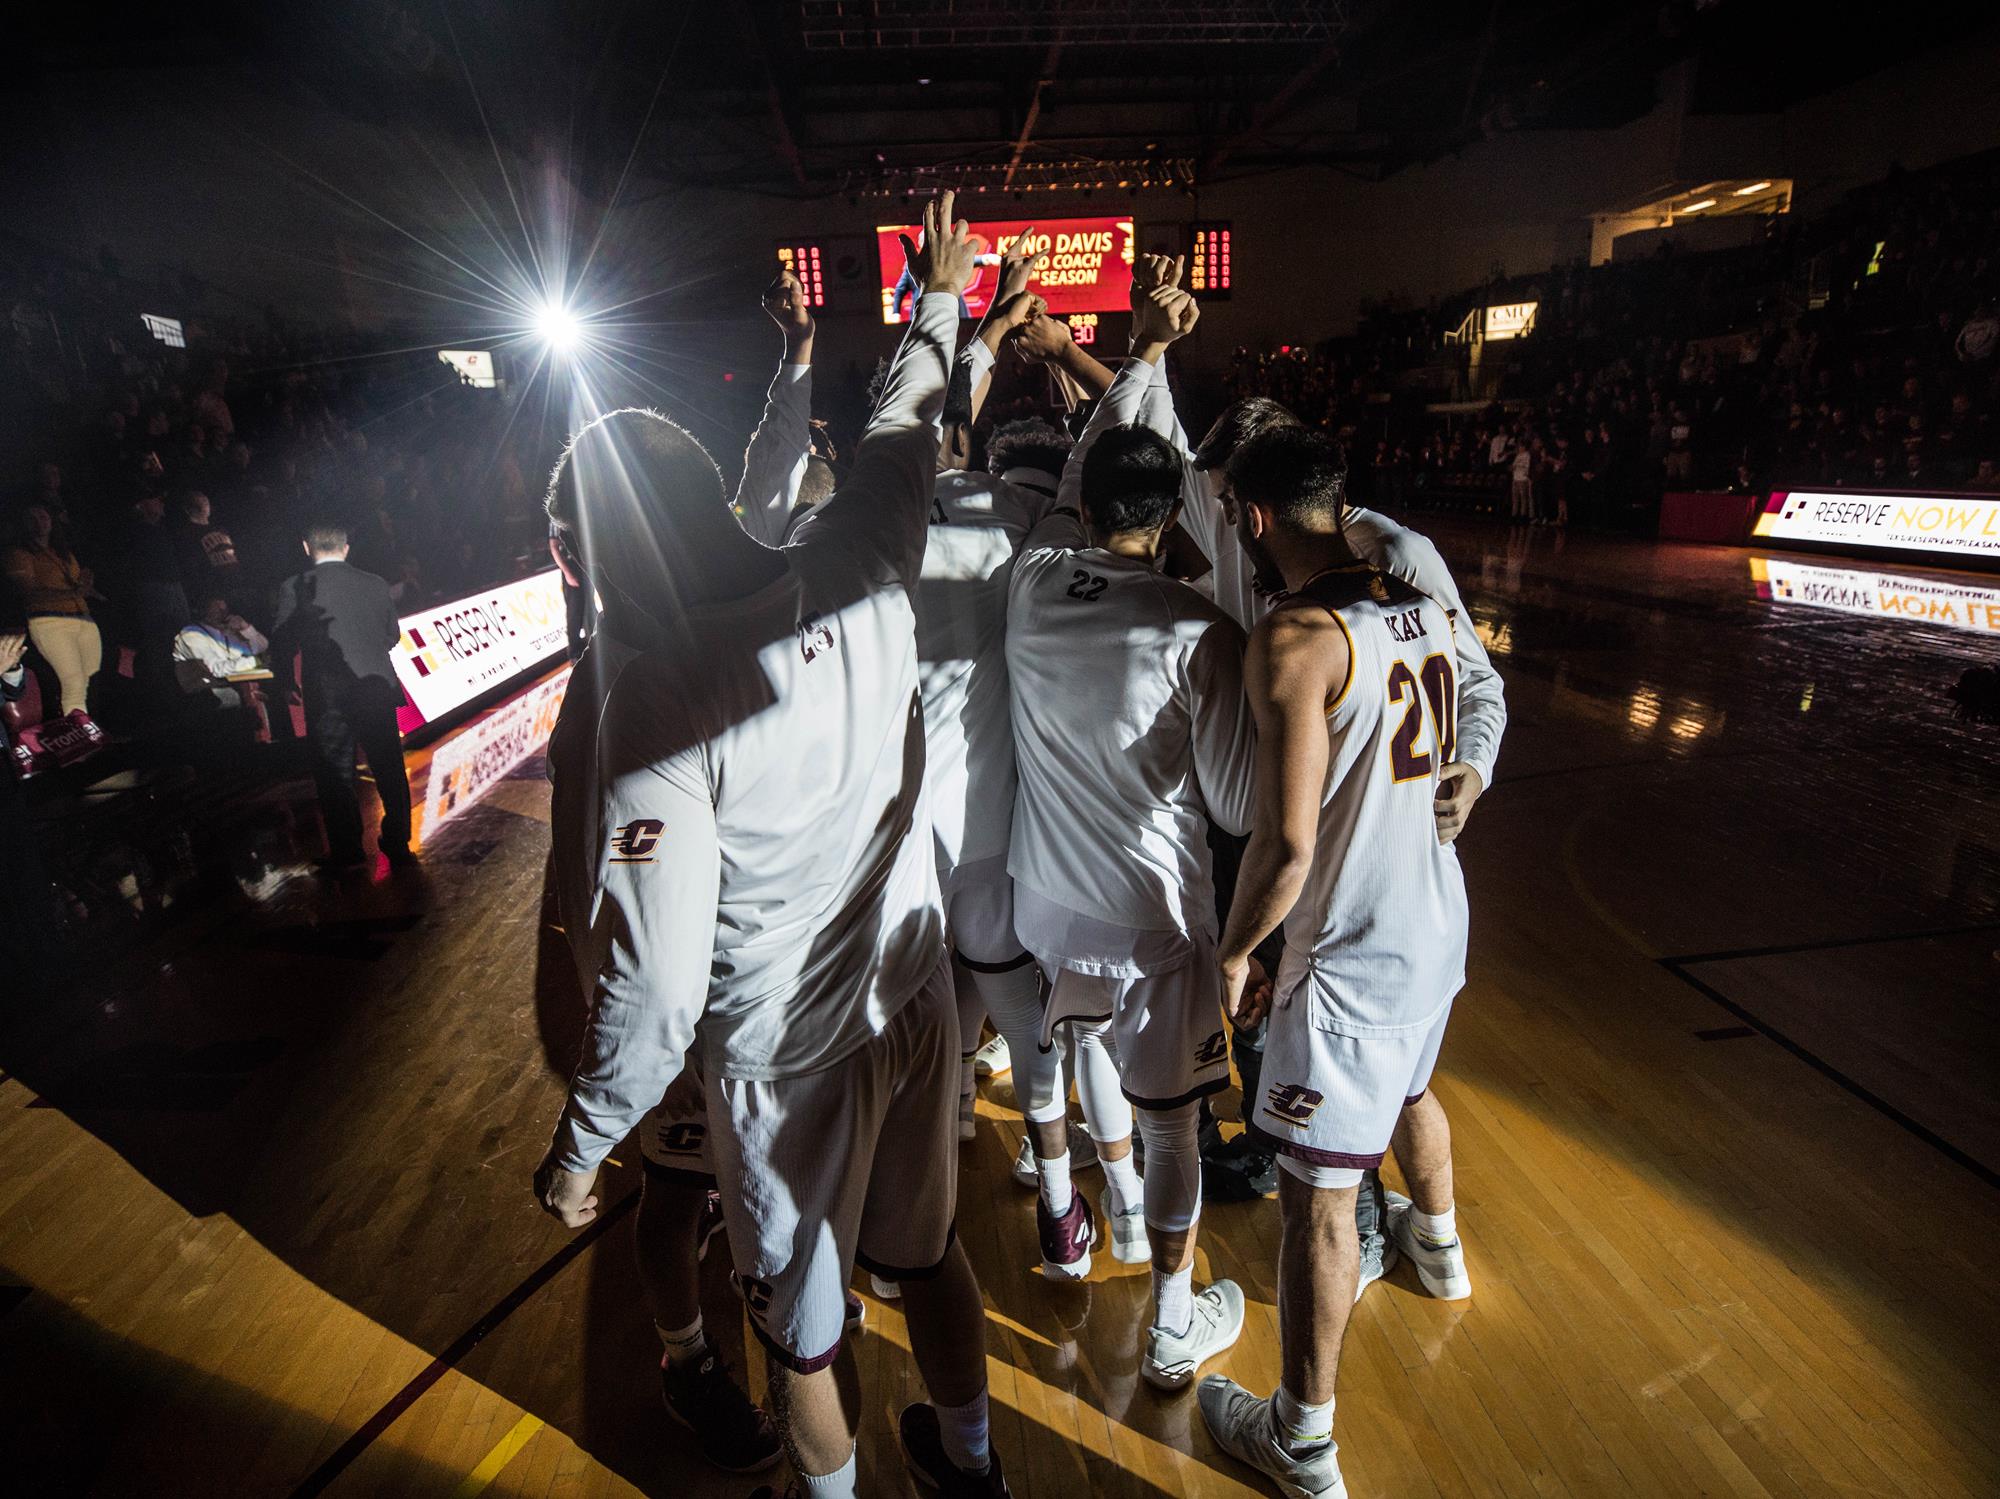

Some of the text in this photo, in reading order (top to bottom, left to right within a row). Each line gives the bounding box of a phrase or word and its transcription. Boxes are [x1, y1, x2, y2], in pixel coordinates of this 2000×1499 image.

[1056, 232, 1113, 254] DAVIS
[1052, 253, 1102, 269] COACH
[1040, 269, 1098, 286] SEASON
[1813, 501, 1891, 526] RESERVE
[1891, 505, 1981, 531] NOW
[1067, 569, 1109, 602] 22
[433, 600, 516, 662] RESERVE
[1387, 652, 1455, 784] 20
